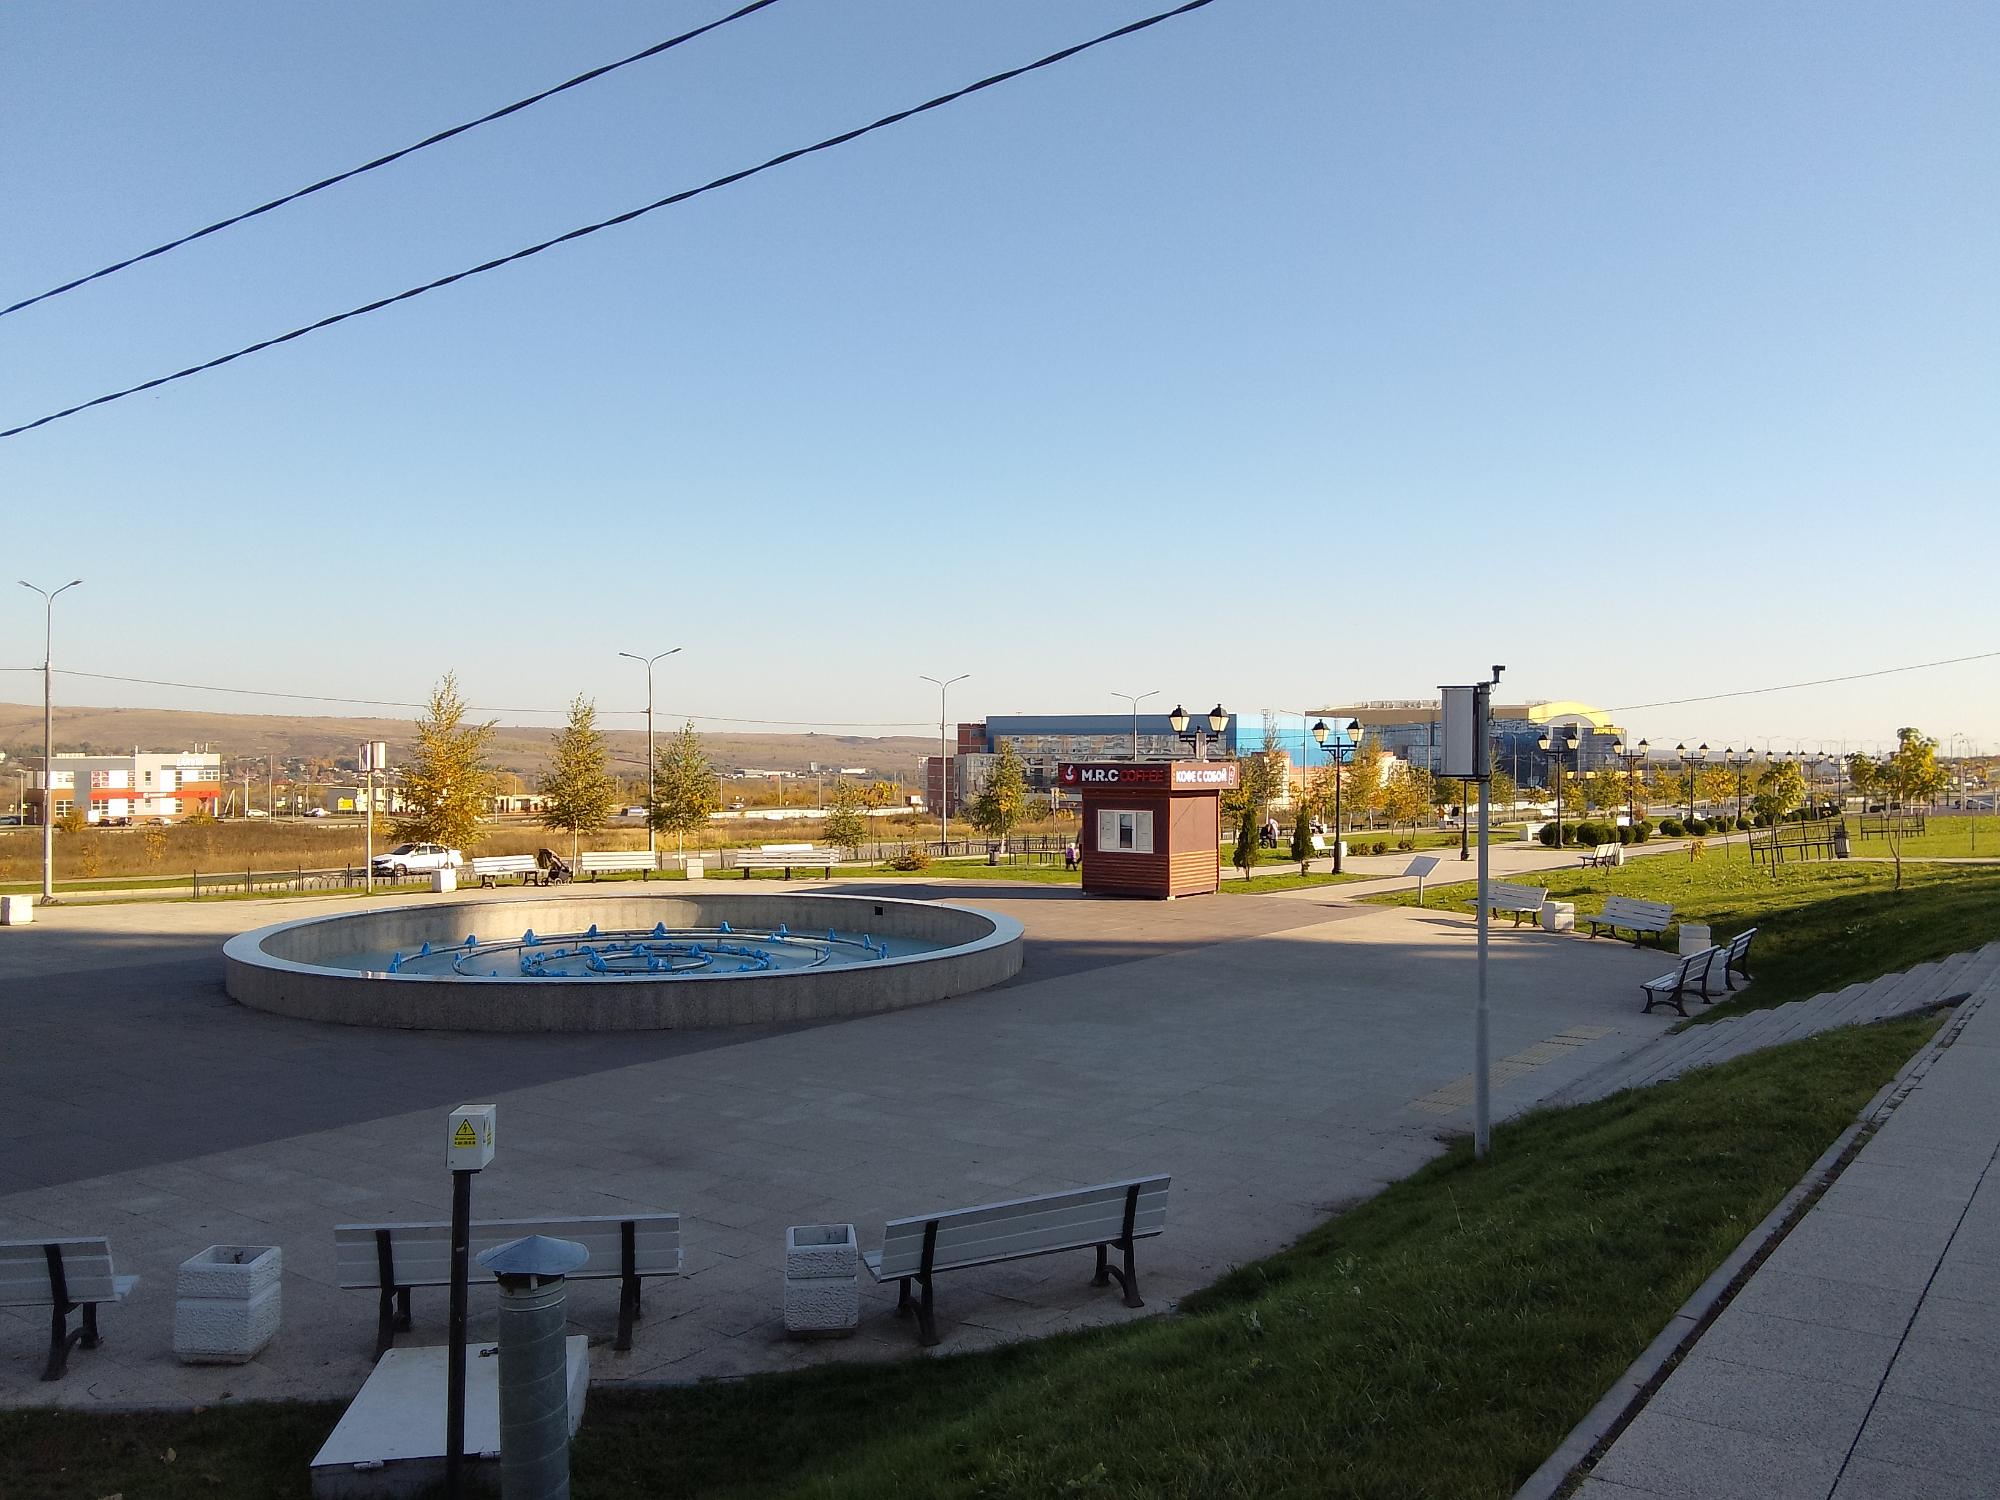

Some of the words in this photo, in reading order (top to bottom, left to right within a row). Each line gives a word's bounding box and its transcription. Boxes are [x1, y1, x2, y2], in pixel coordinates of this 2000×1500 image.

[1081, 769, 1119, 782] M.R.C
[1120, 769, 1164, 782] COFFEE
[1176, 770, 1196, 783] КОФЕ
[1203, 768, 1227, 782] СОБОЙ
